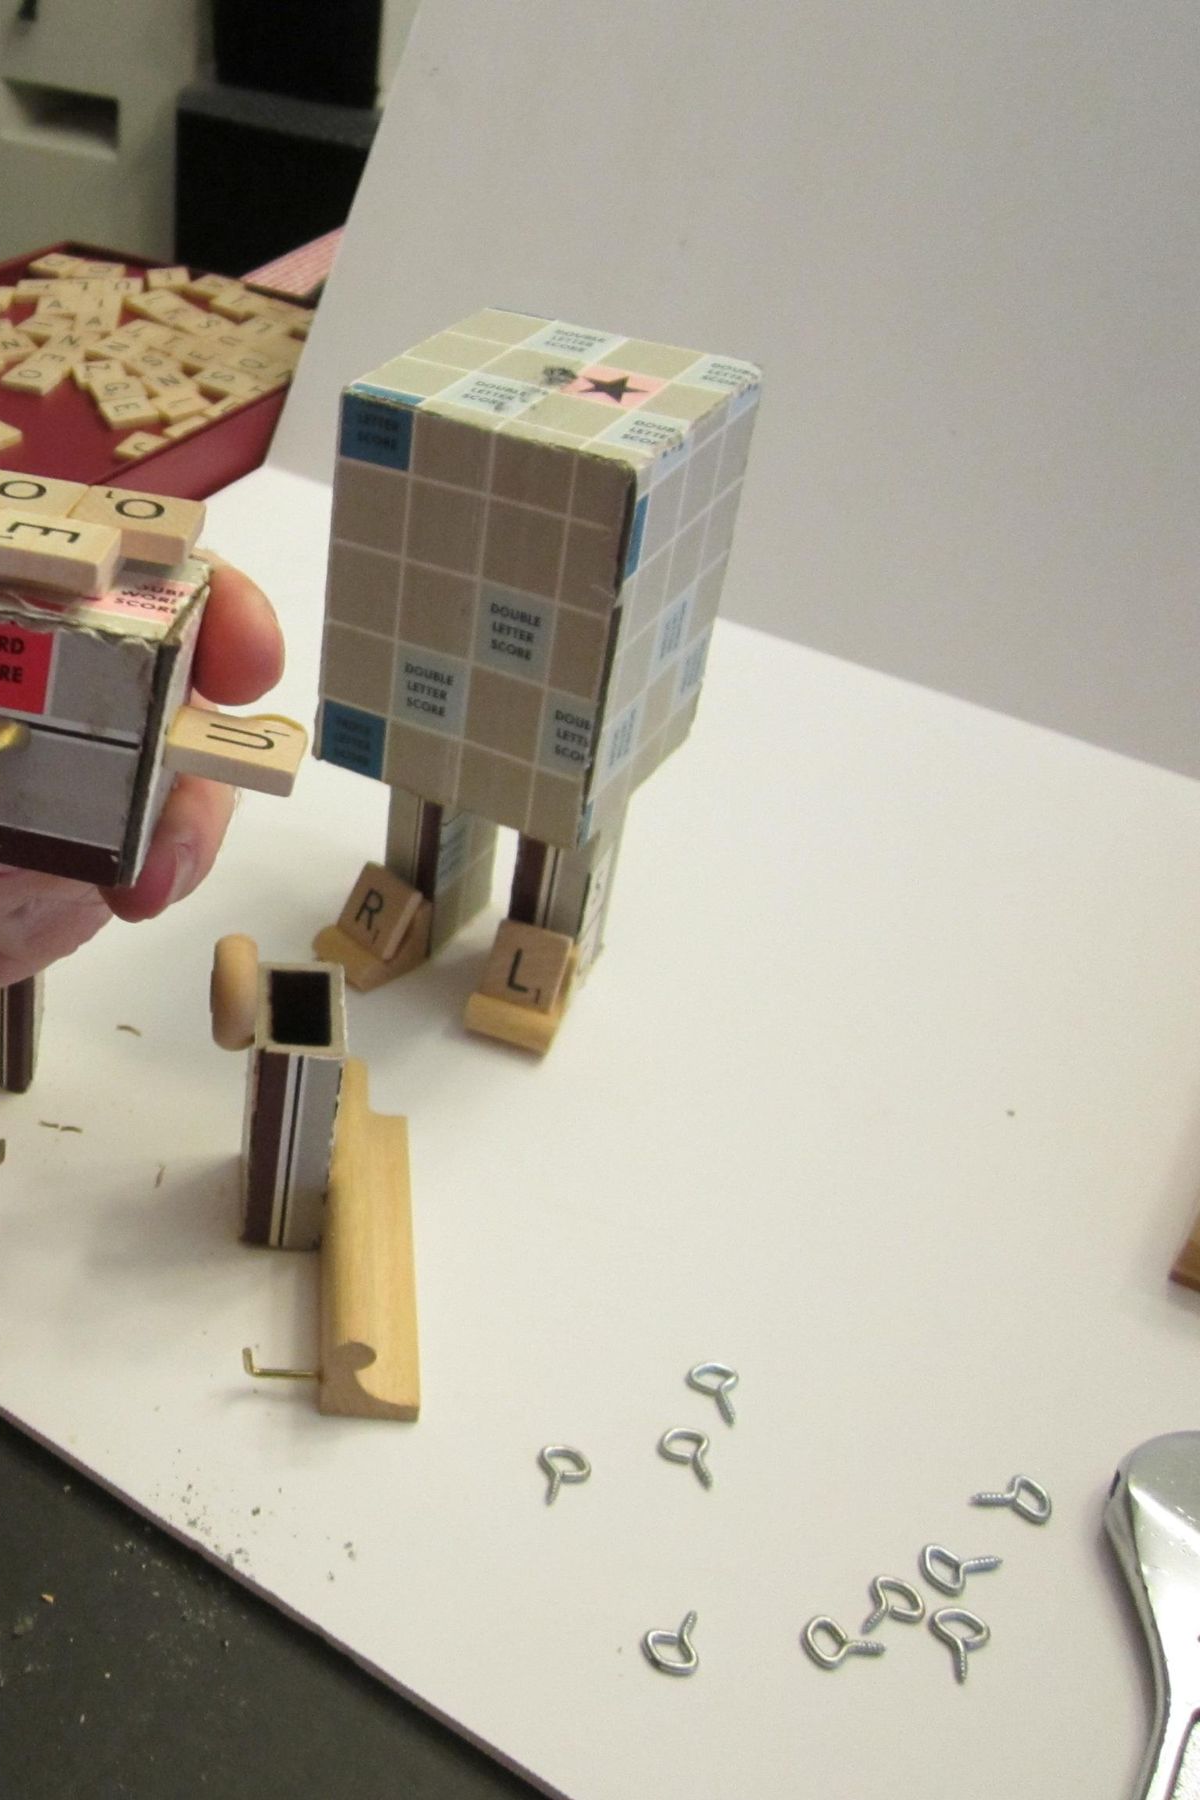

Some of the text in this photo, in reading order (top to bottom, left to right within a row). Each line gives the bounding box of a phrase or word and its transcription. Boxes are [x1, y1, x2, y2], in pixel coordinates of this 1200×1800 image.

[114, 499, 166, 520] O
[6, 521, 81, 544] E
[490, 603, 542, 628] DOUBLE
[492, 621, 535, 643] LETTER
[490, 639, 532, 661] SCORE
[404, 662, 455, 687] DOUBLE
[406, 680, 448, 701] LETTER
[406, 697, 446, 717] SCORE
[205, 722, 275, 750] U
[354, 887, 384, 931] R
[506, 947, 530, 993] L
